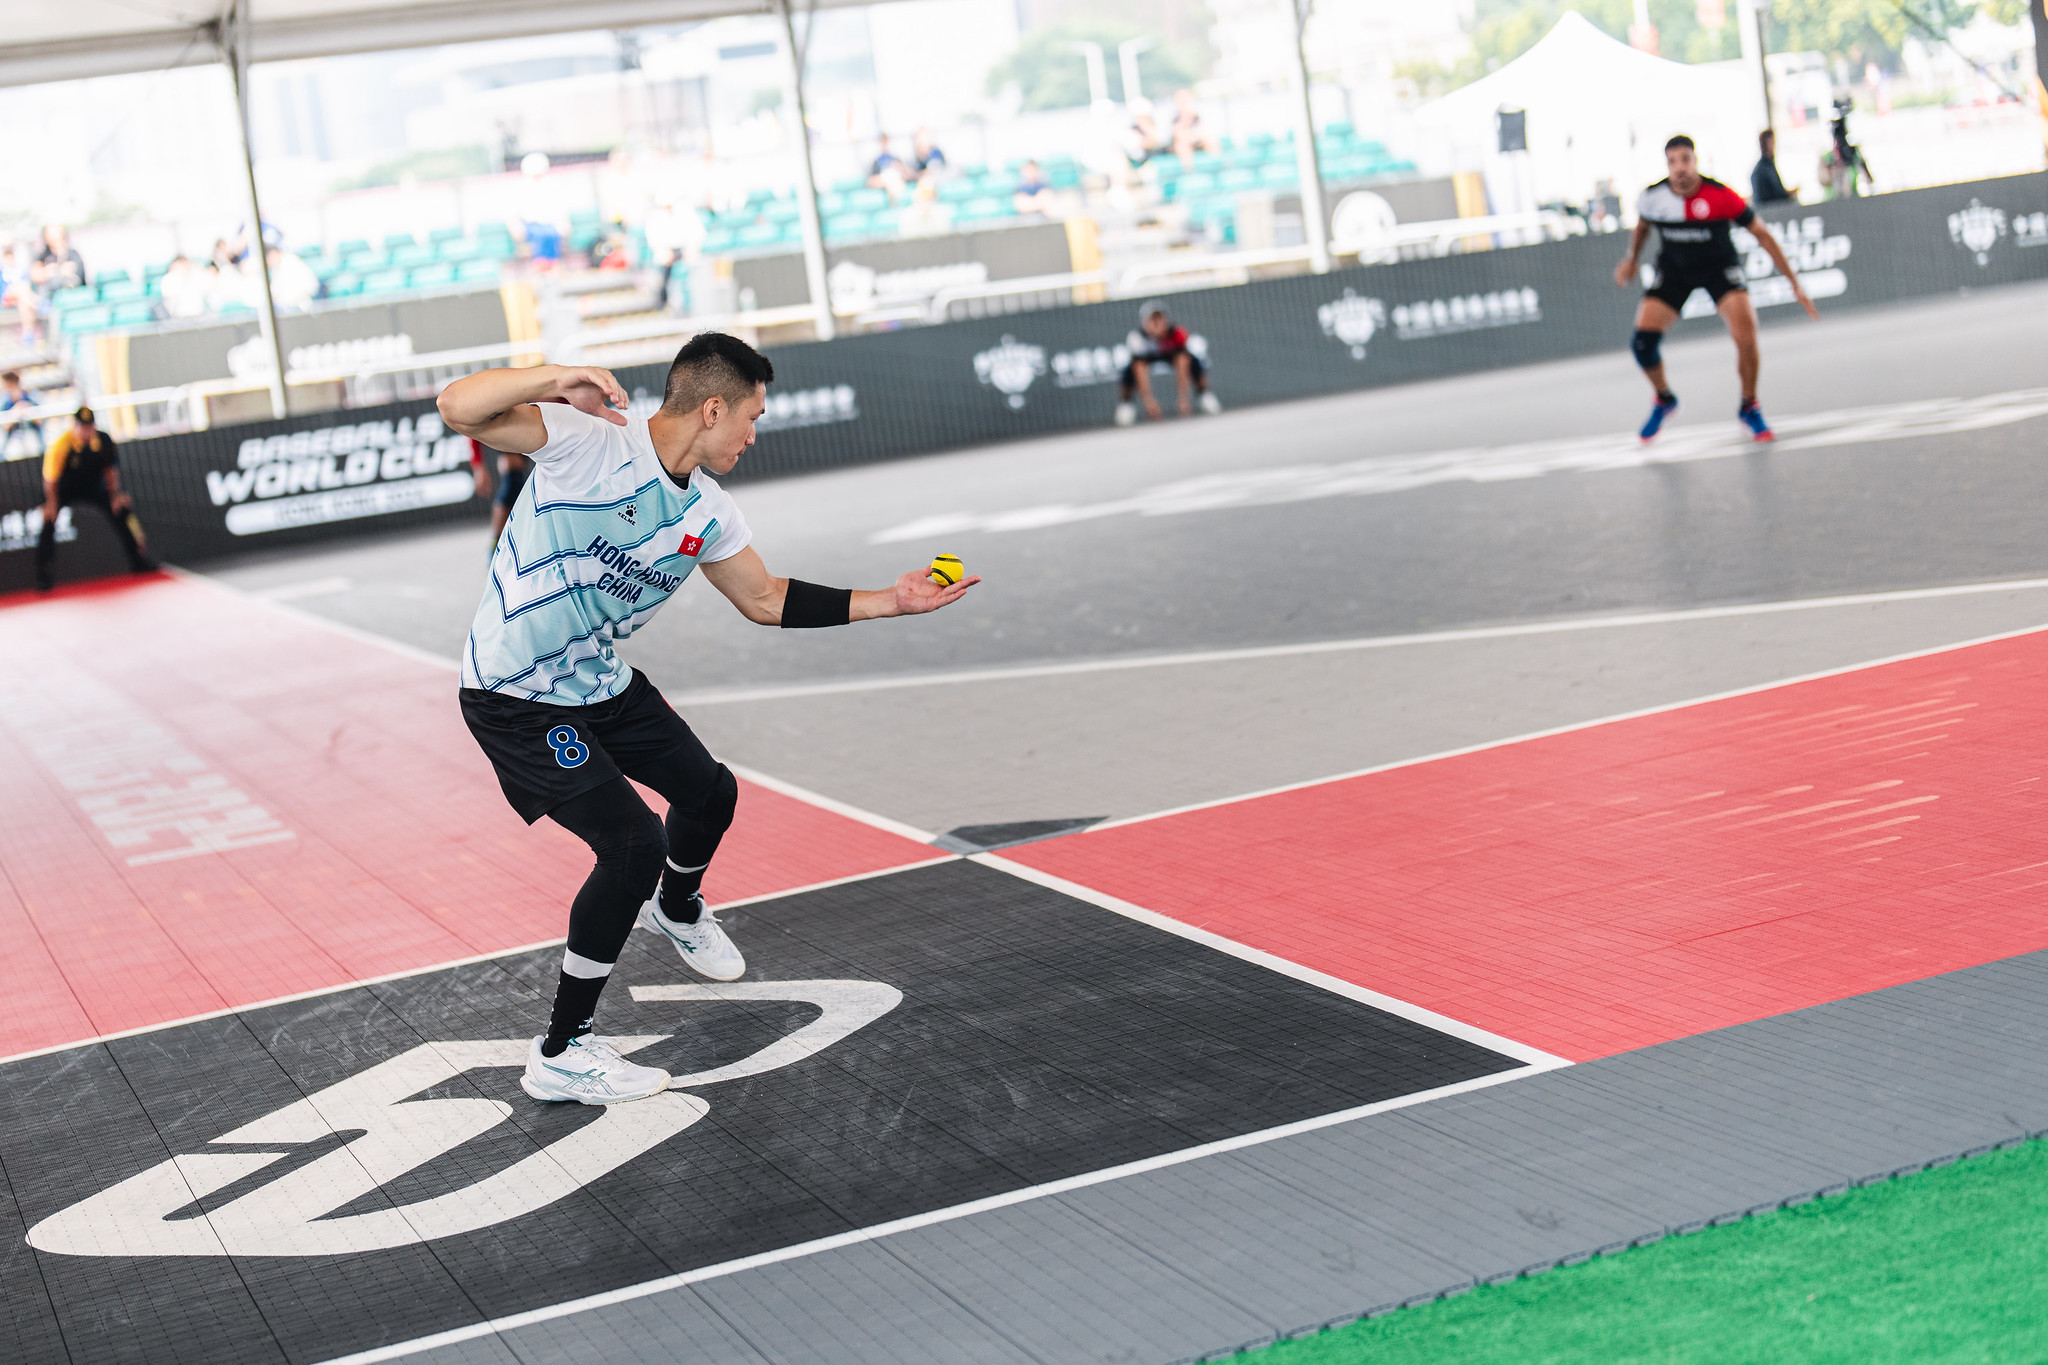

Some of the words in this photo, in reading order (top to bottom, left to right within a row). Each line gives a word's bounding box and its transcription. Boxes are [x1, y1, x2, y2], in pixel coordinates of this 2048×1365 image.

[206, 448, 380, 506] WORLD
[617, 511, 636, 527] KELME
[586, 534, 641, 577] HONG
[634, 566, 681, 593] KONG
[596, 572, 645, 605] CHINA
[546, 724, 590, 769] 8
